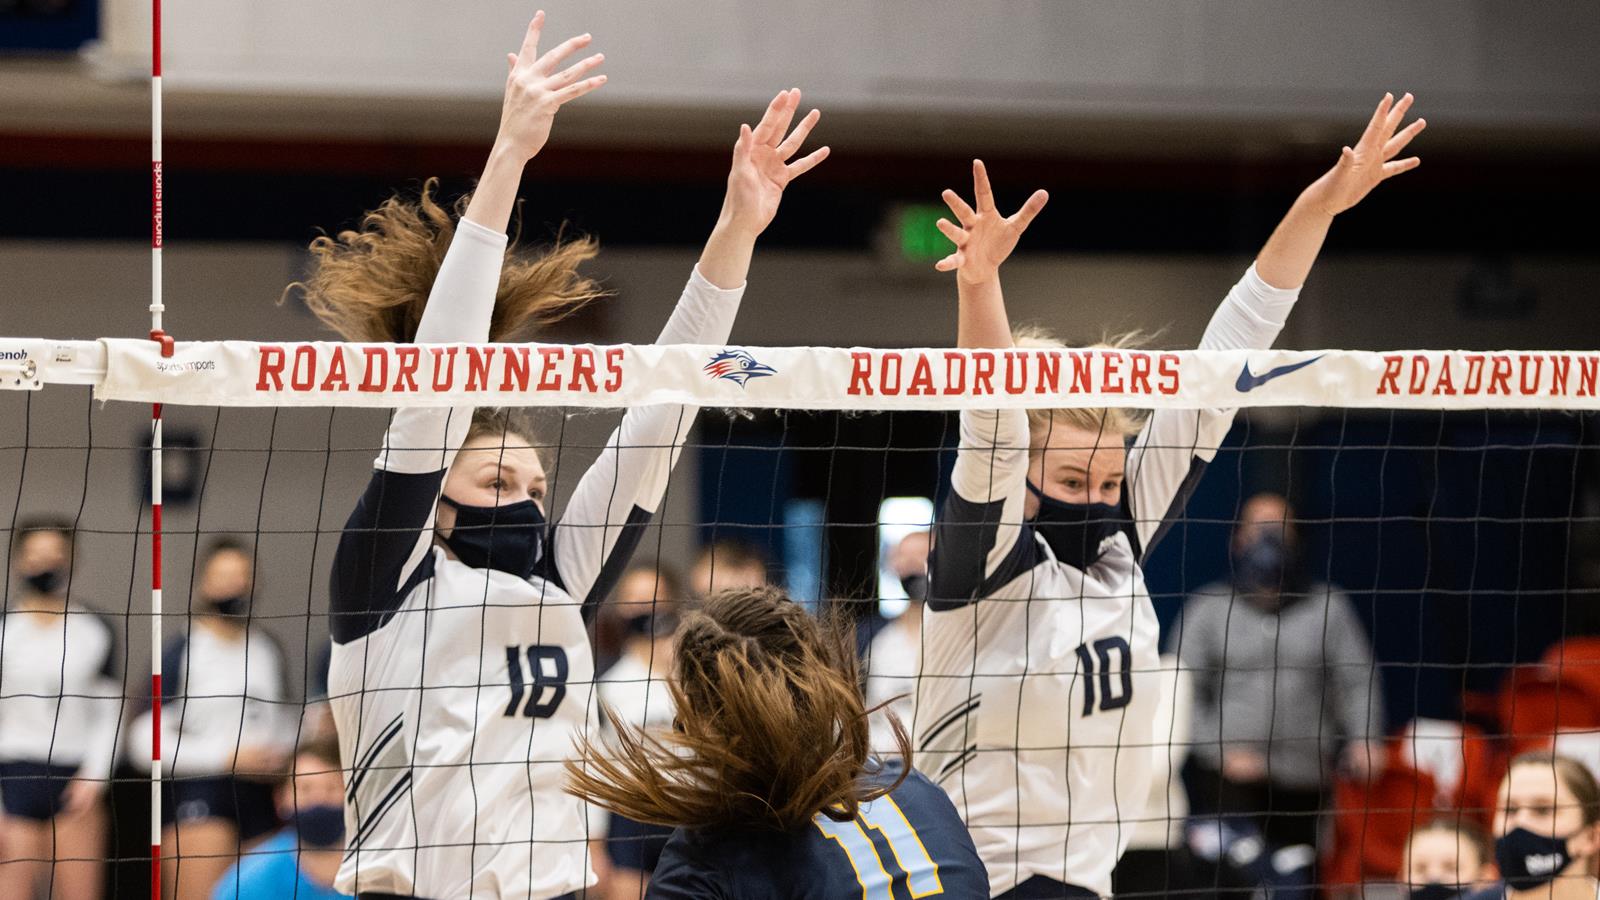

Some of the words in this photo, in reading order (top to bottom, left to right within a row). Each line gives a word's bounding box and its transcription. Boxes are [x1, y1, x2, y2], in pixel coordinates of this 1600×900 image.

[255, 345, 625, 393] ROADRUNNERS
[847, 351, 1181, 396] ROADRUNNERS
[1376, 354, 1600, 397] ROADRUNN
[503, 645, 569, 719] 18
[1074, 635, 1133, 718] 10
[811, 788, 944, 900] 11
